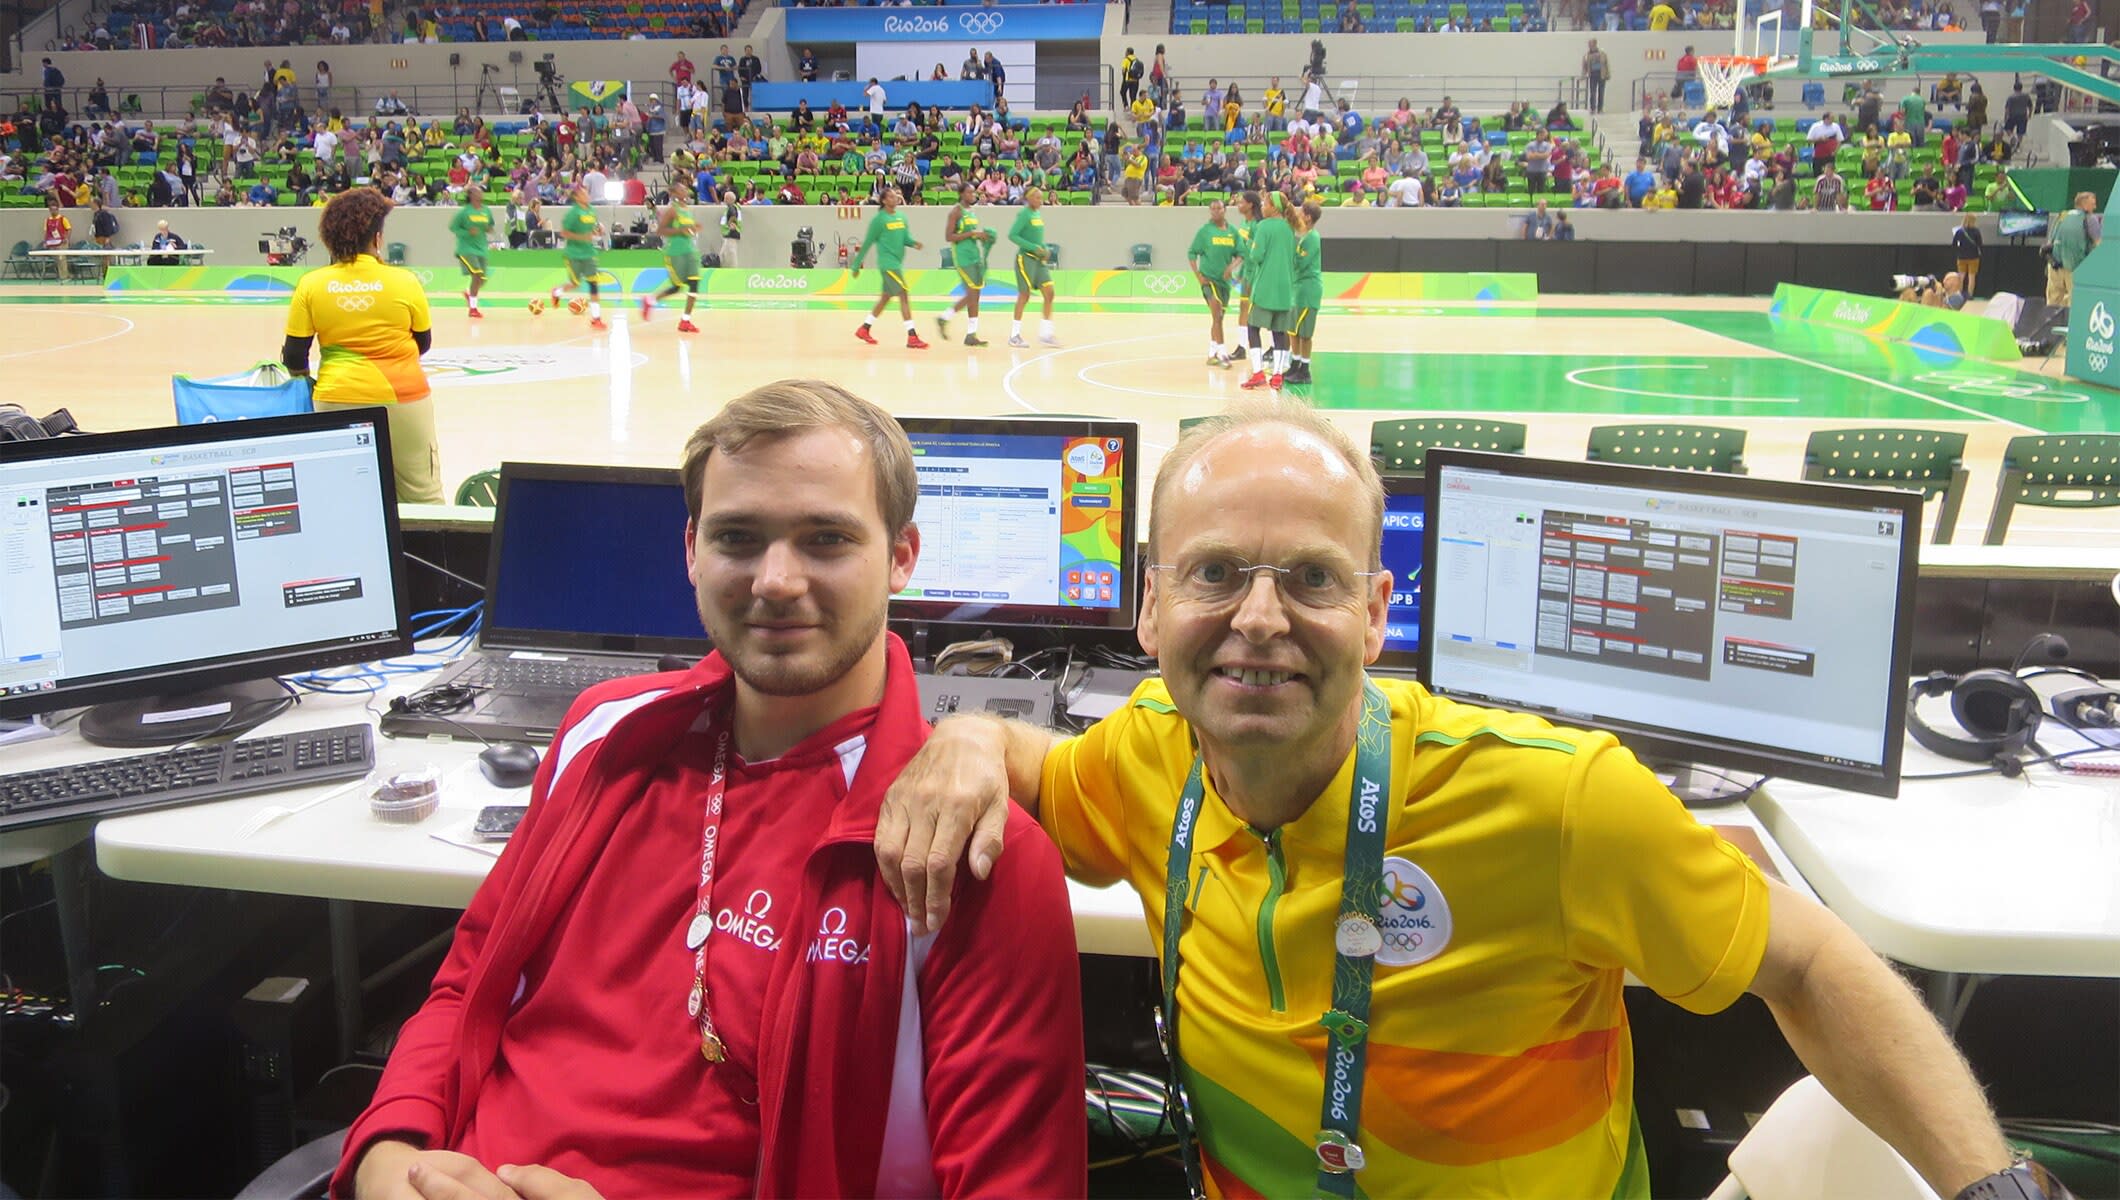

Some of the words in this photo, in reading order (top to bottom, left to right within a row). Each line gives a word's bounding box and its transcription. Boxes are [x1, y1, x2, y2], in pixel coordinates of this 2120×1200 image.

[884, 15, 949, 33] Rio2016
[327, 279, 384, 294] Rio2016
[748, 273, 807, 289] Rio2016
[1405, 594, 1413, 605] B
[711, 731, 729, 785] OMEGA
[1358, 776, 1380, 832] Atos
[1175, 798, 1195, 848] Atos
[701, 825, 717, 887] OMEGA
